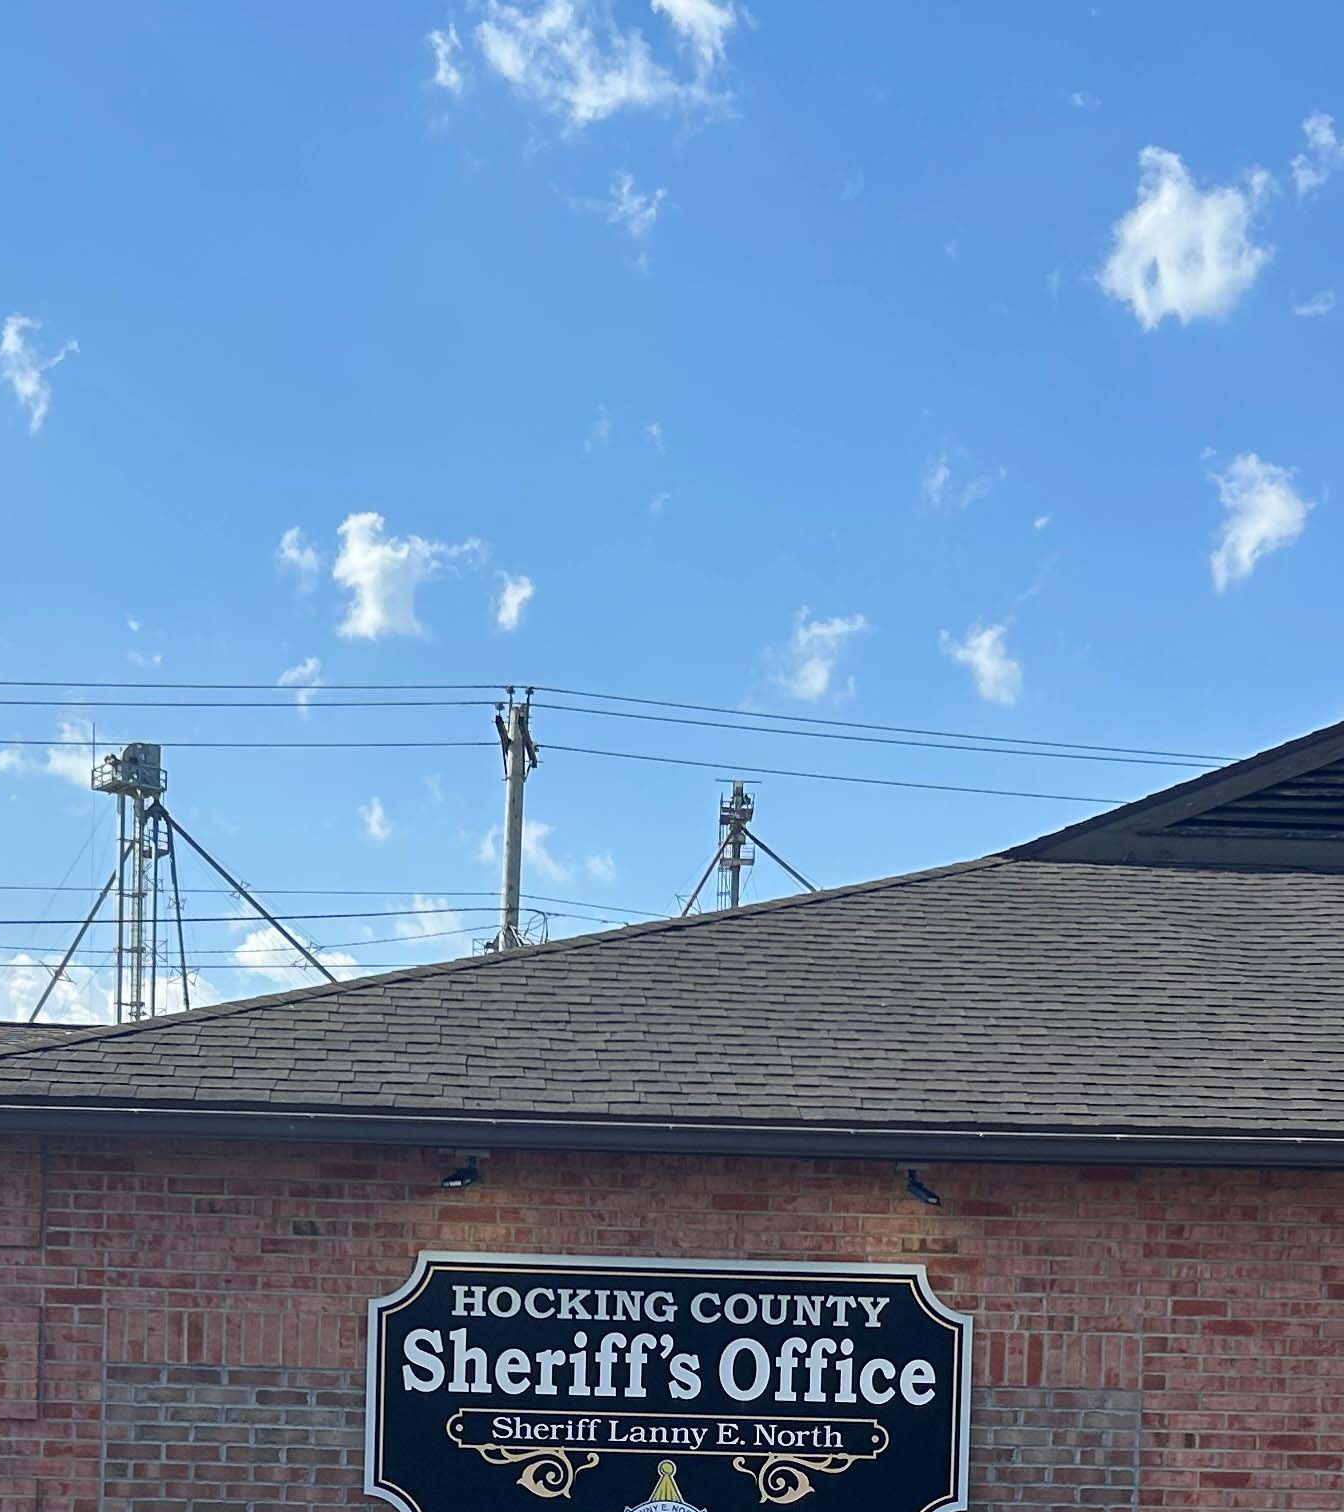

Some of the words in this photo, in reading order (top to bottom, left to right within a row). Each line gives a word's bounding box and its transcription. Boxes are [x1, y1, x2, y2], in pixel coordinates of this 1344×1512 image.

[451, 1285, 678, 1323] HOCKING
[690, 1291, 890, 1328] COUNTY
[402, 1327, 702, 1400] Sheriff's
[719, 1337, 936, 1406] Office
[492, 1416, 601, 1442] Sheriff
[608, 1419, 708, 1451] Lanny
[716, 1423, 746, 1446] E.
[754, 1424, 844, 1448] North
